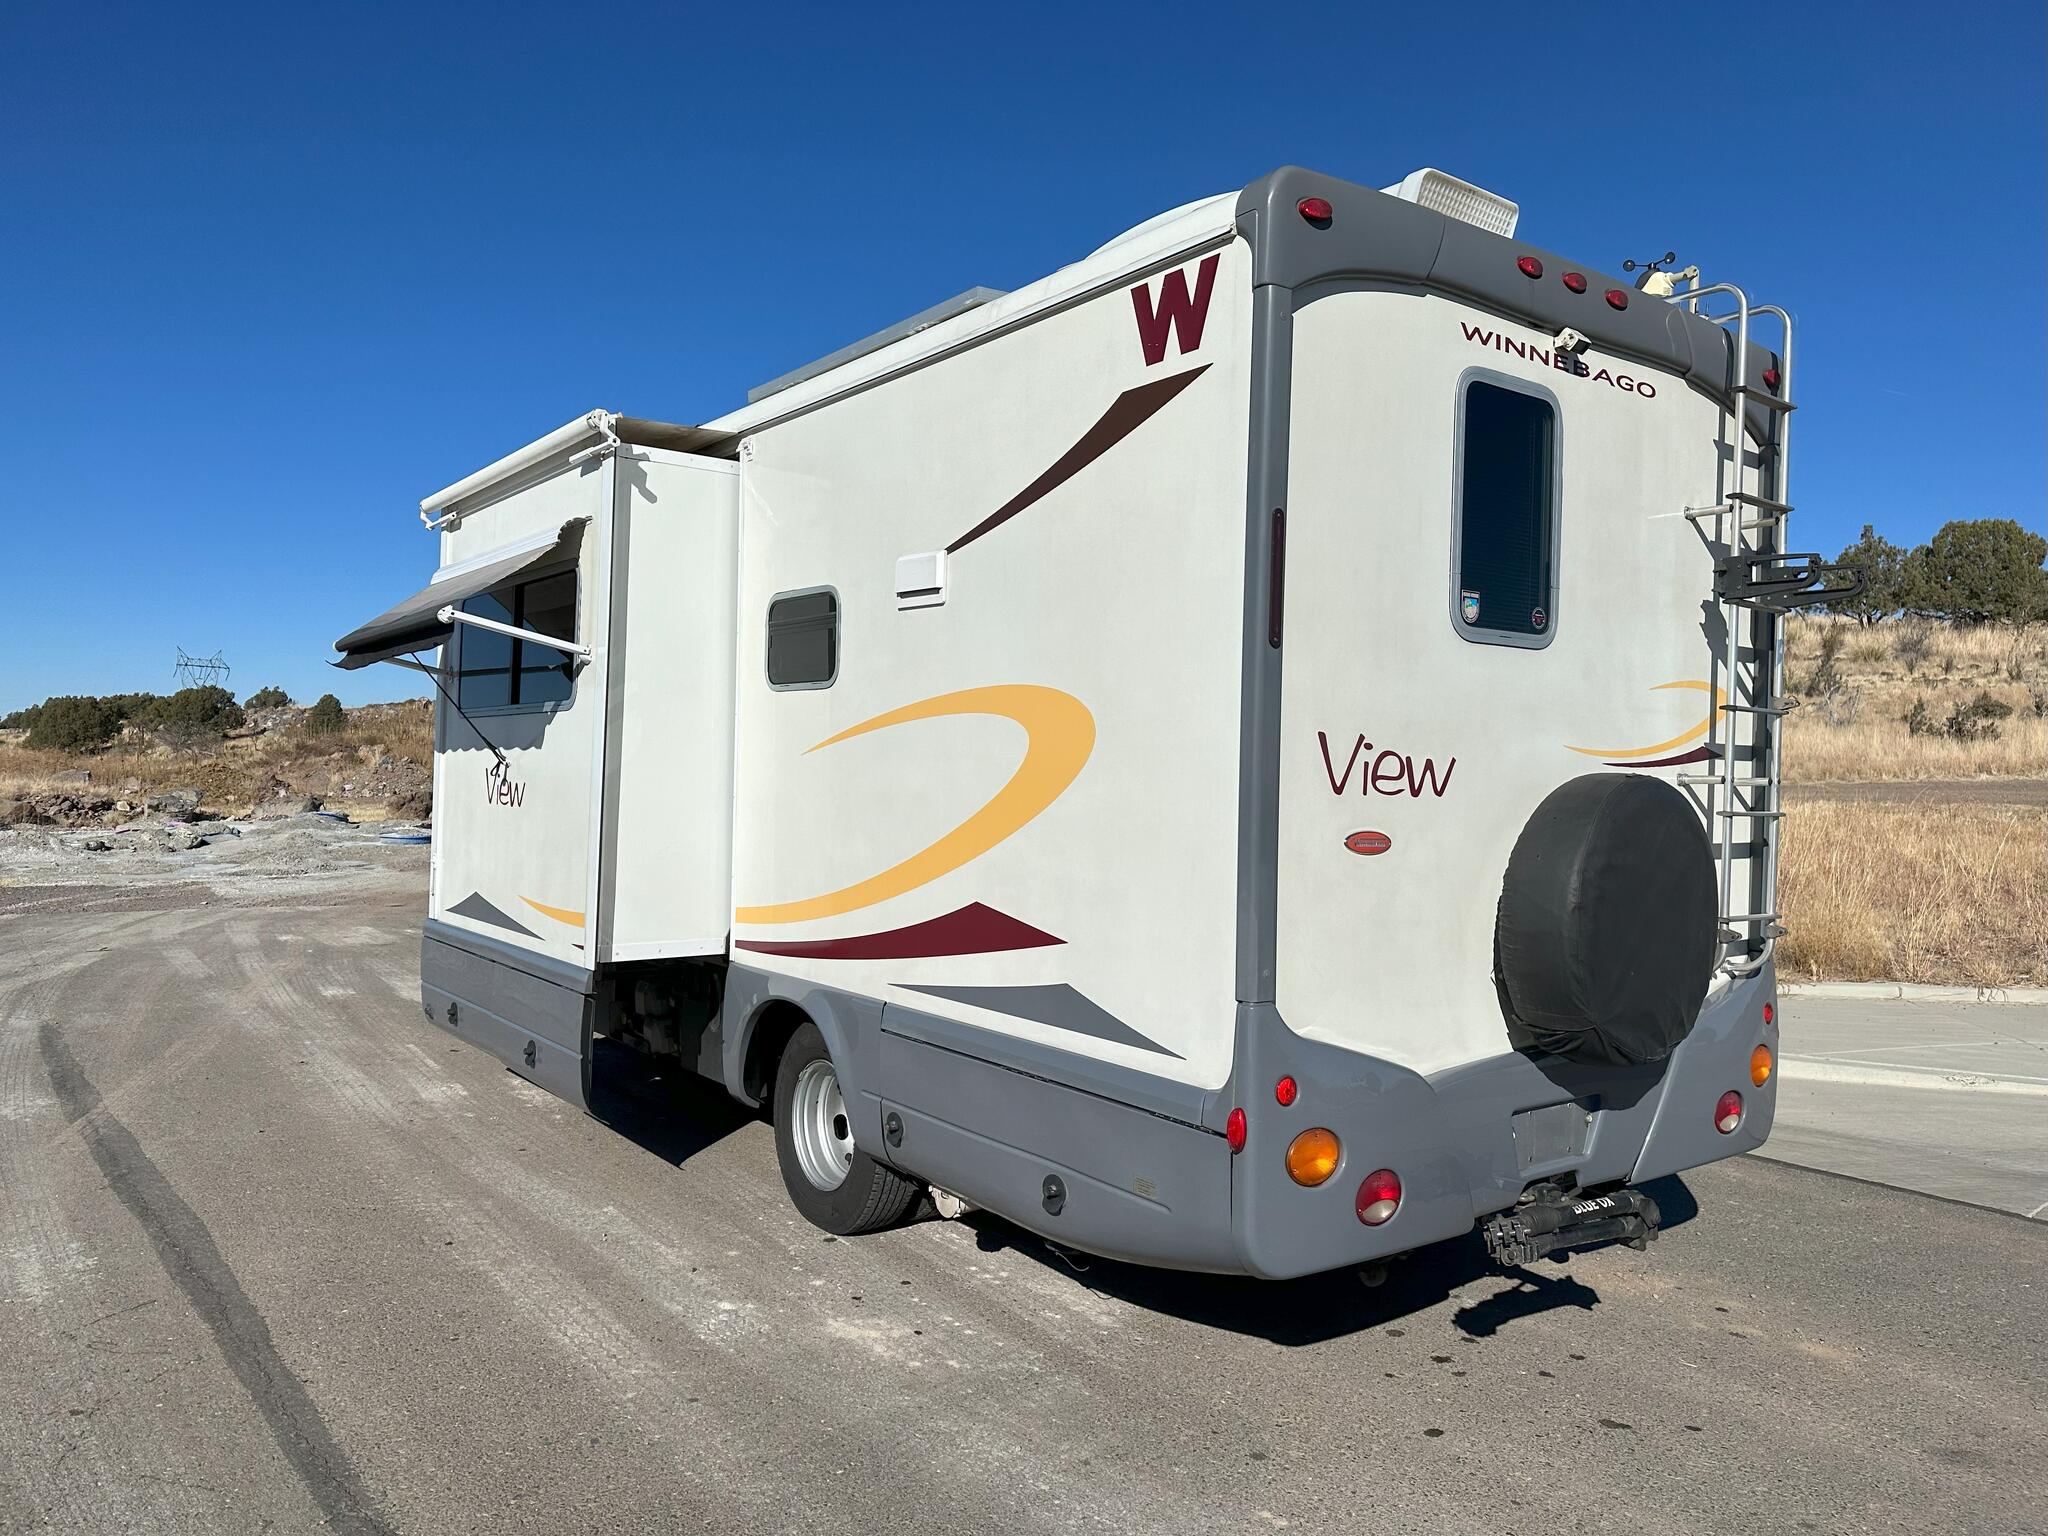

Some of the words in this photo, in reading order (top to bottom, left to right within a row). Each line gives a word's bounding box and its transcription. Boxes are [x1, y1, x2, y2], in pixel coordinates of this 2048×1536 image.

[1130, 252, 1221, 367] W
[1460, 321, 1657, 399] WINNEBAGO
[485, 767, 526, 807] View
[1317, 731, 1457, 798] View
[1572, 1200, 1600, 1215] BLUE
